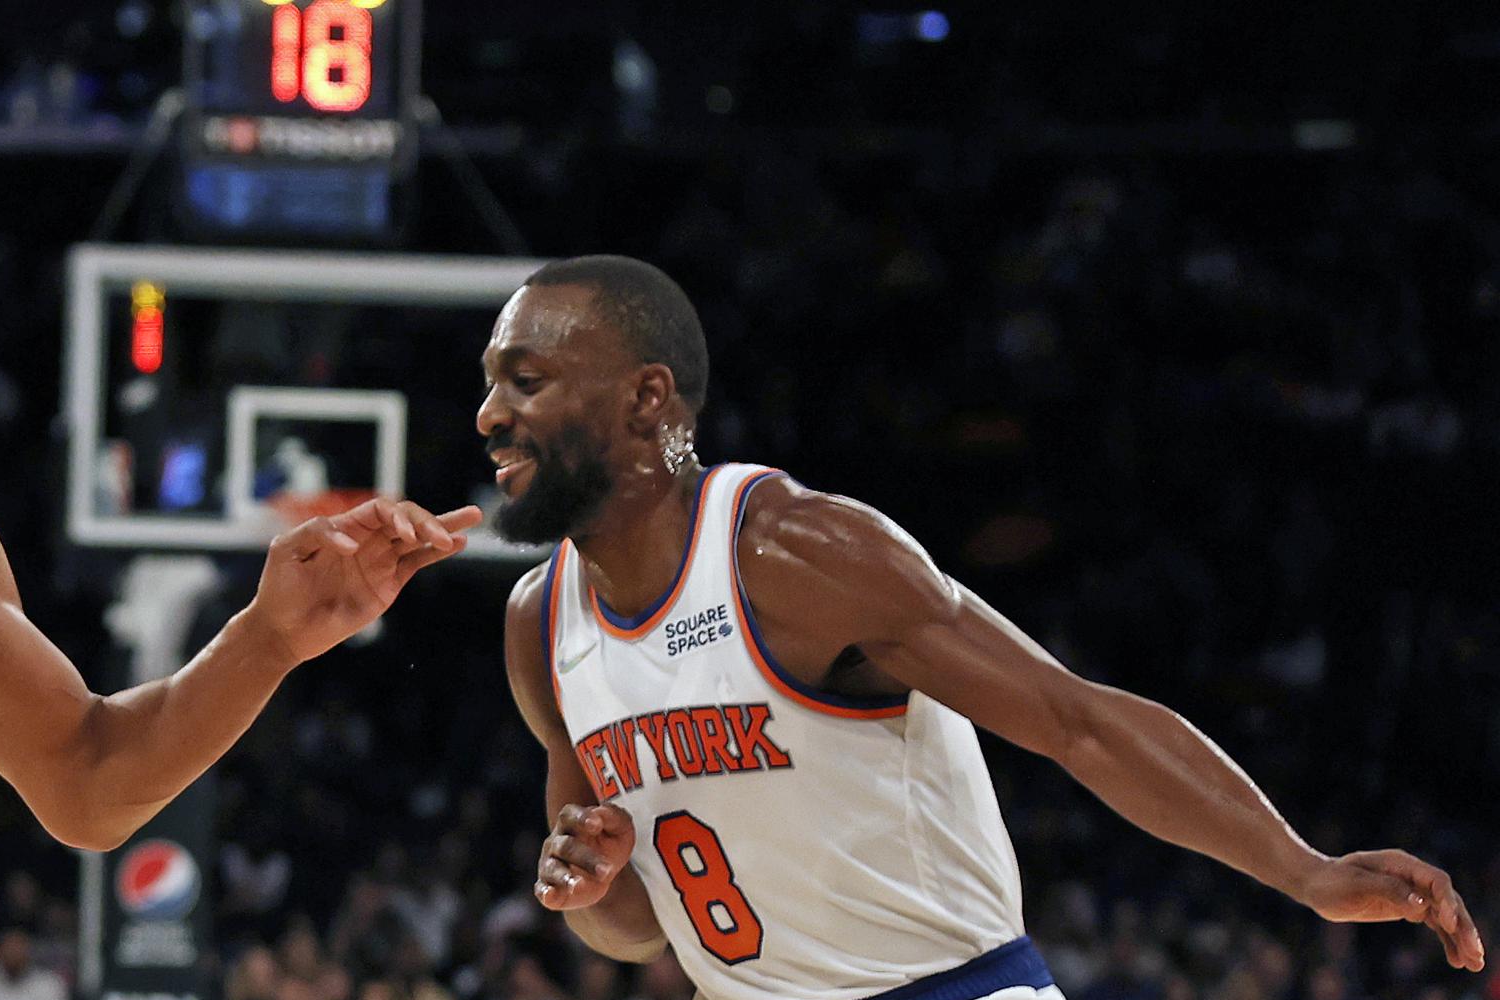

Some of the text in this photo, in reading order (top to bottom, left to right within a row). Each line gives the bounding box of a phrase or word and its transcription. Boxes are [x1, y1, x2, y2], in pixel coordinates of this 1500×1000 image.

[271, 0, 373, 111] 18
[665, 604, 728, 638] SQUARE
[667, 626, 718, 656] SPACE
[636, 703, 795, 782] YORK
[653, 809, 764, 966] 8
